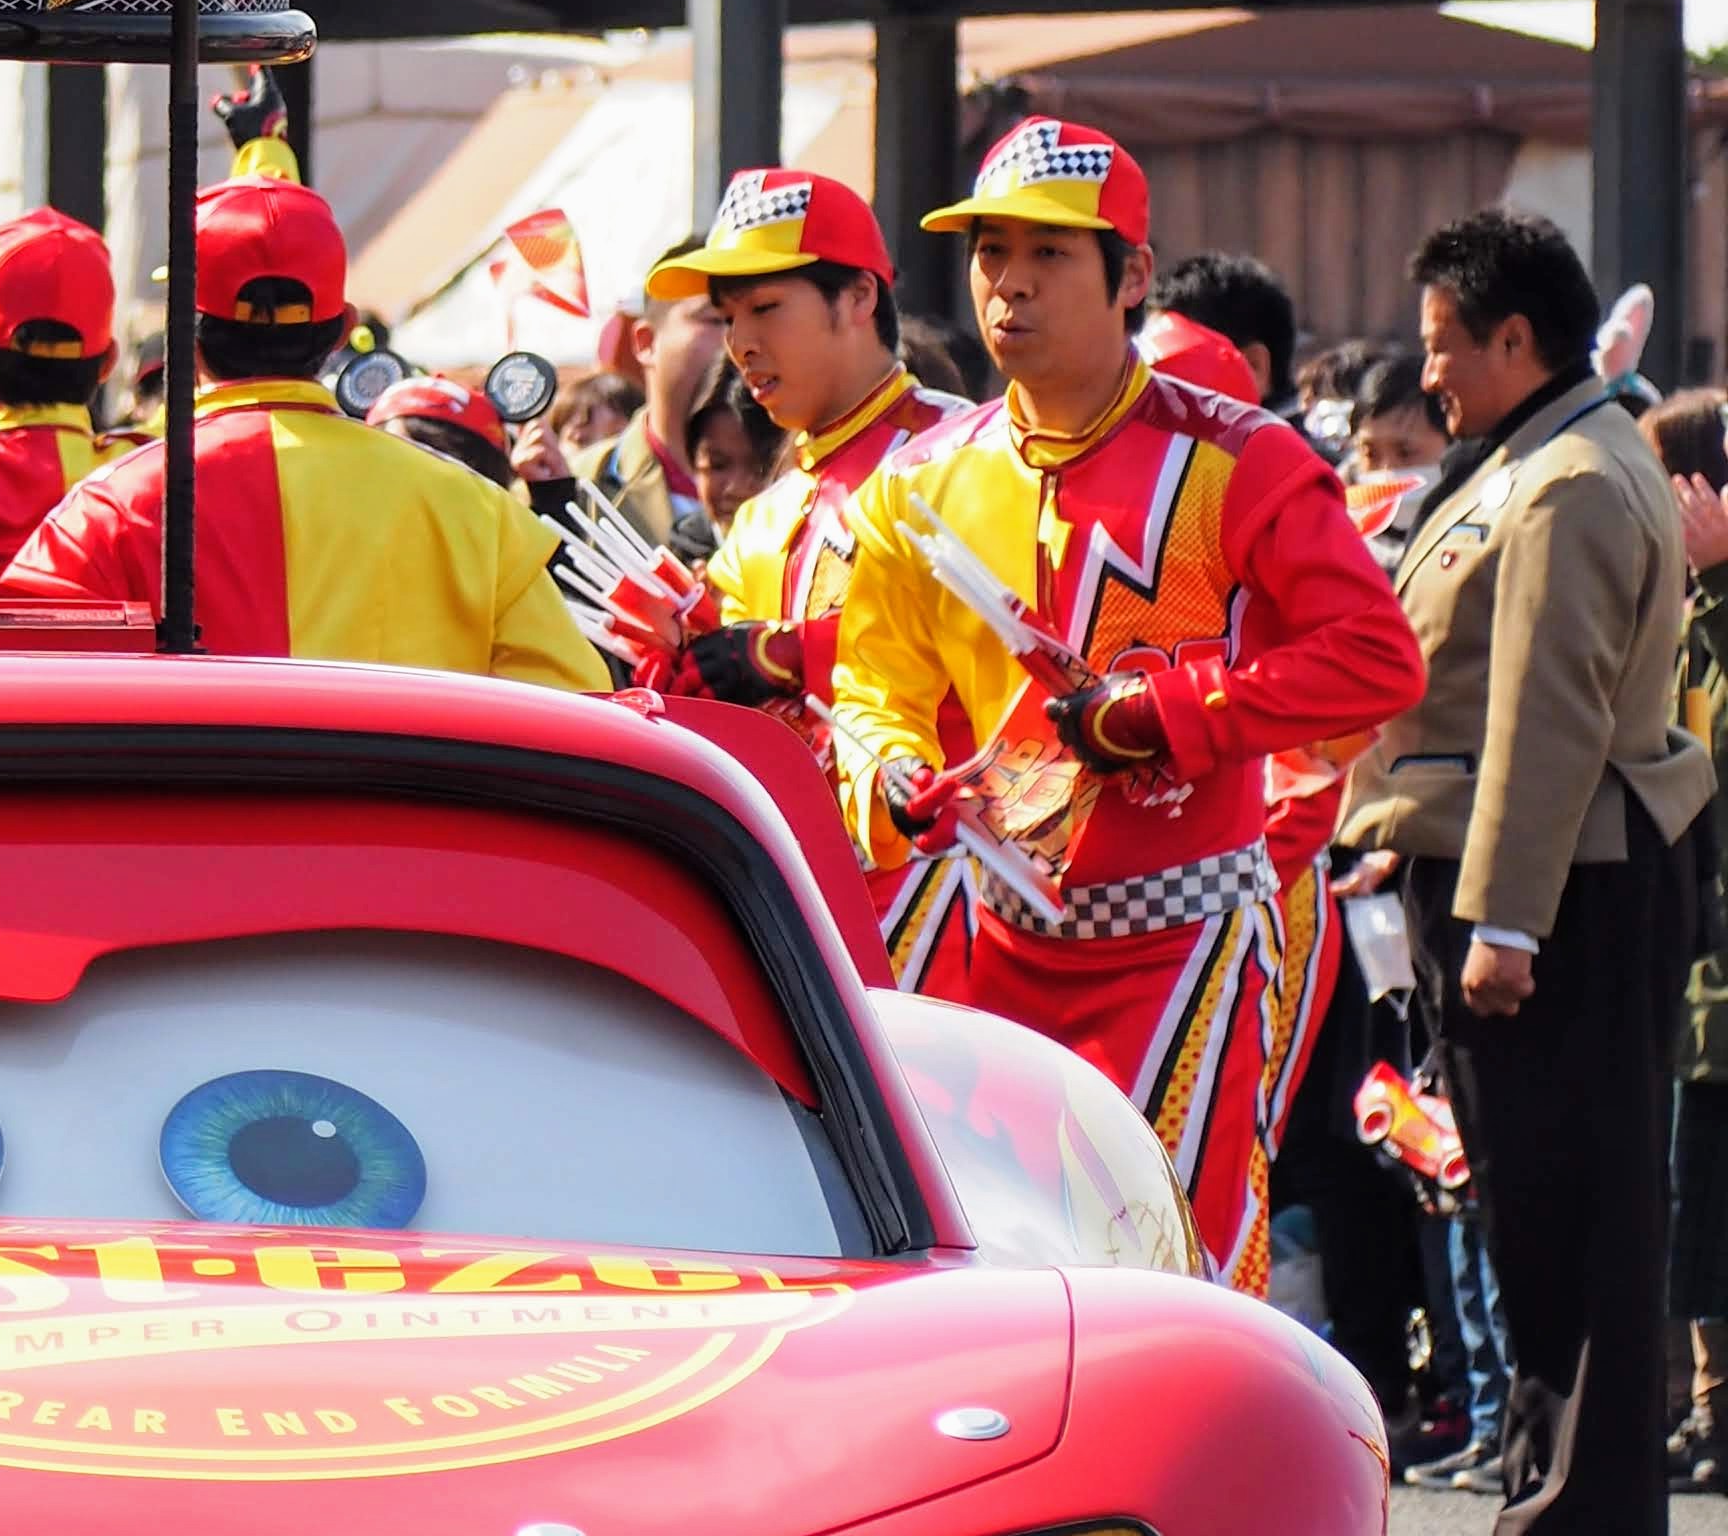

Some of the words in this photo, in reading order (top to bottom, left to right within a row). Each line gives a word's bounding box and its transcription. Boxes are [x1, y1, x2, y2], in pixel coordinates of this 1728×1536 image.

[285, 1303, 717, 1332] OINTMENT
[215, 1407, 358, 1438] END
[383, 1342, 653, 1426] FORMULA
